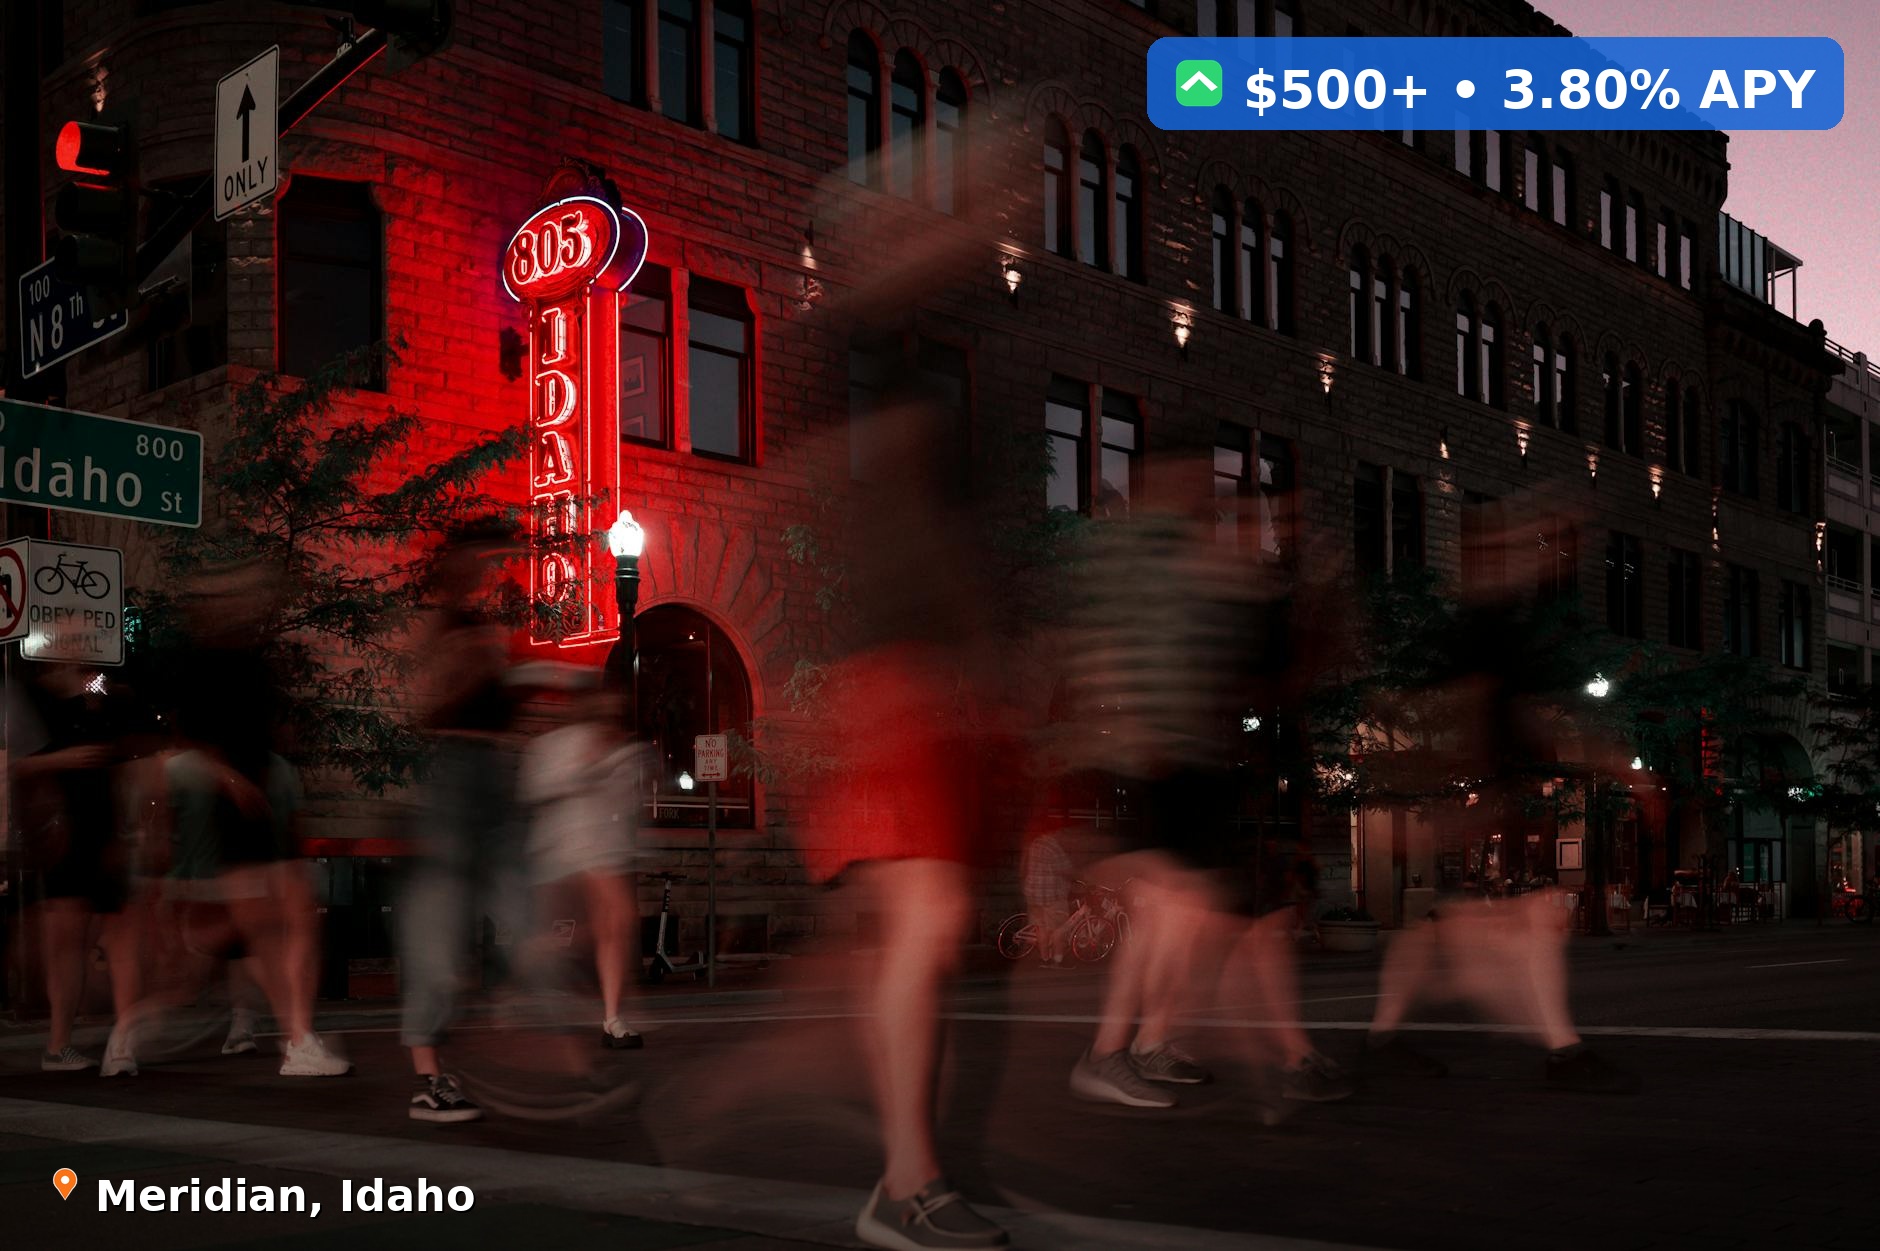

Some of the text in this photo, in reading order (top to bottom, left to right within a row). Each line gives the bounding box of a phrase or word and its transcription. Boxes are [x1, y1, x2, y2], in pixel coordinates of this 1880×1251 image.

[224, 156, 269, 202] ONLY
[511, 210, 593, 286] 805
[28, 274, 51, 306] 100
[30, 311, 44, 362] N
[136, 434, 184, 462] 800
[533, 307, 577, 605] IDAHO
[160, 490, 183, 514] St
[30, 604, 115, 629] OBEY PED
[43, 633, 104, 654] SIGNAL
[697, 749, 725, 758] PARKING
[705, 739, 717, 748] NO
[658, 807, 680, 820] FORK
